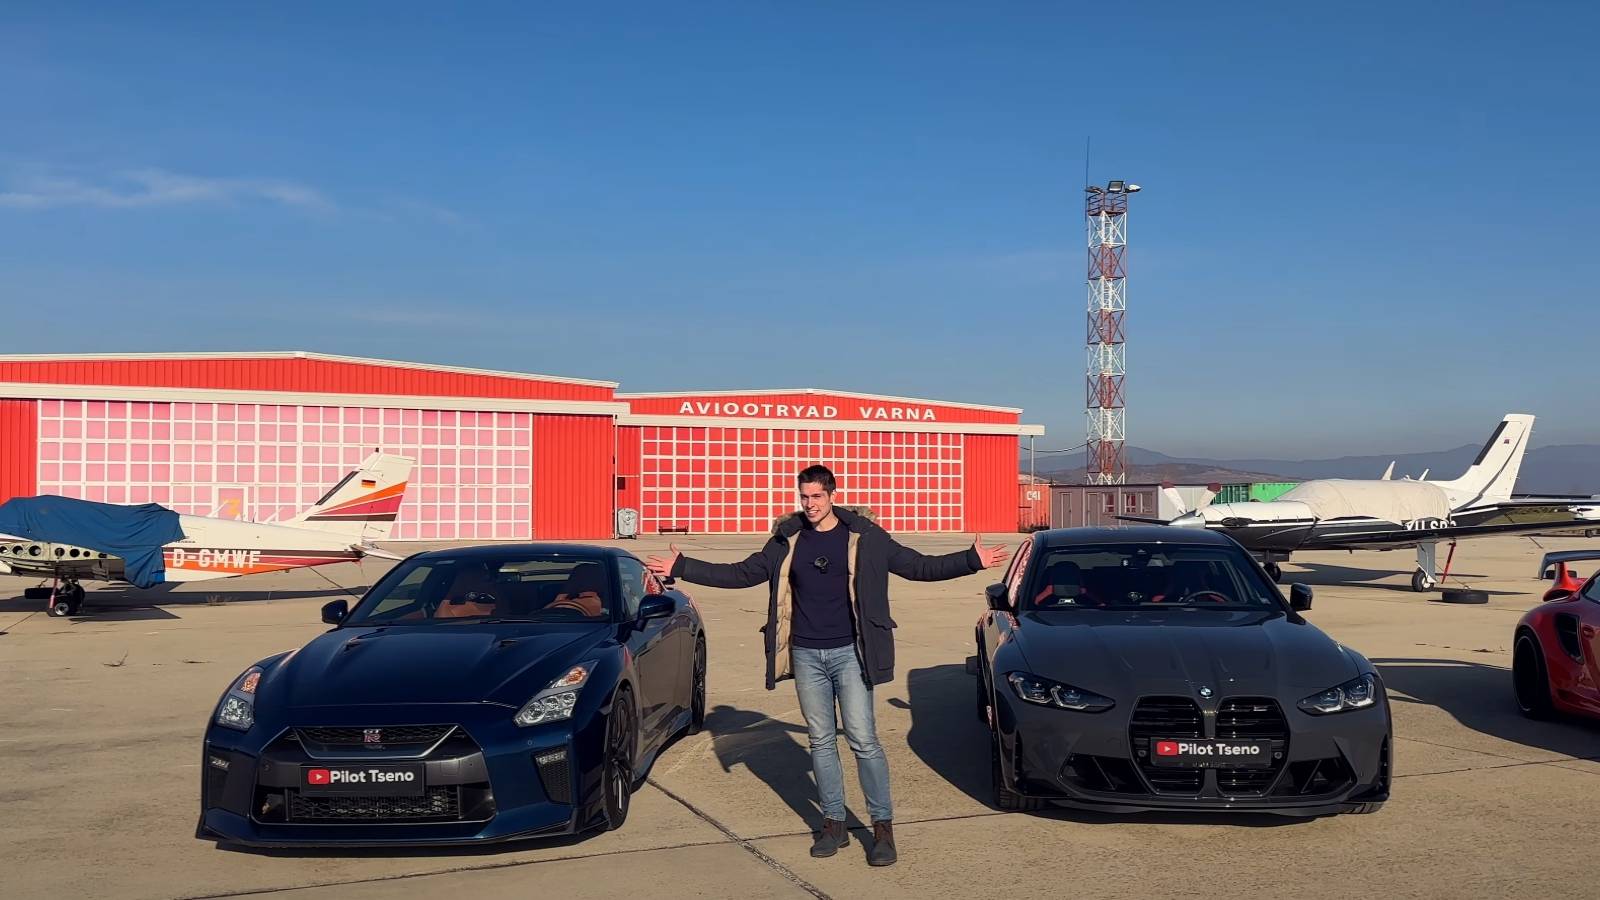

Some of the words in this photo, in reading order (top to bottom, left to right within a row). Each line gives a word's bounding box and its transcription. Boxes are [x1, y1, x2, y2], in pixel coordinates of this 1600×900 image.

[679, 400, 838, 420] AVIOOTRYAD
[859, 406, 937, 421] VARNA
[172, 548, 261, 568] D-GMWF
[1178, 742, 1213, 756] Pilot
[1216, 742, 1260, 755] Tseno
[330, 769, 367, 783] Pilot
[368, 769, 414, 782] Tseno
